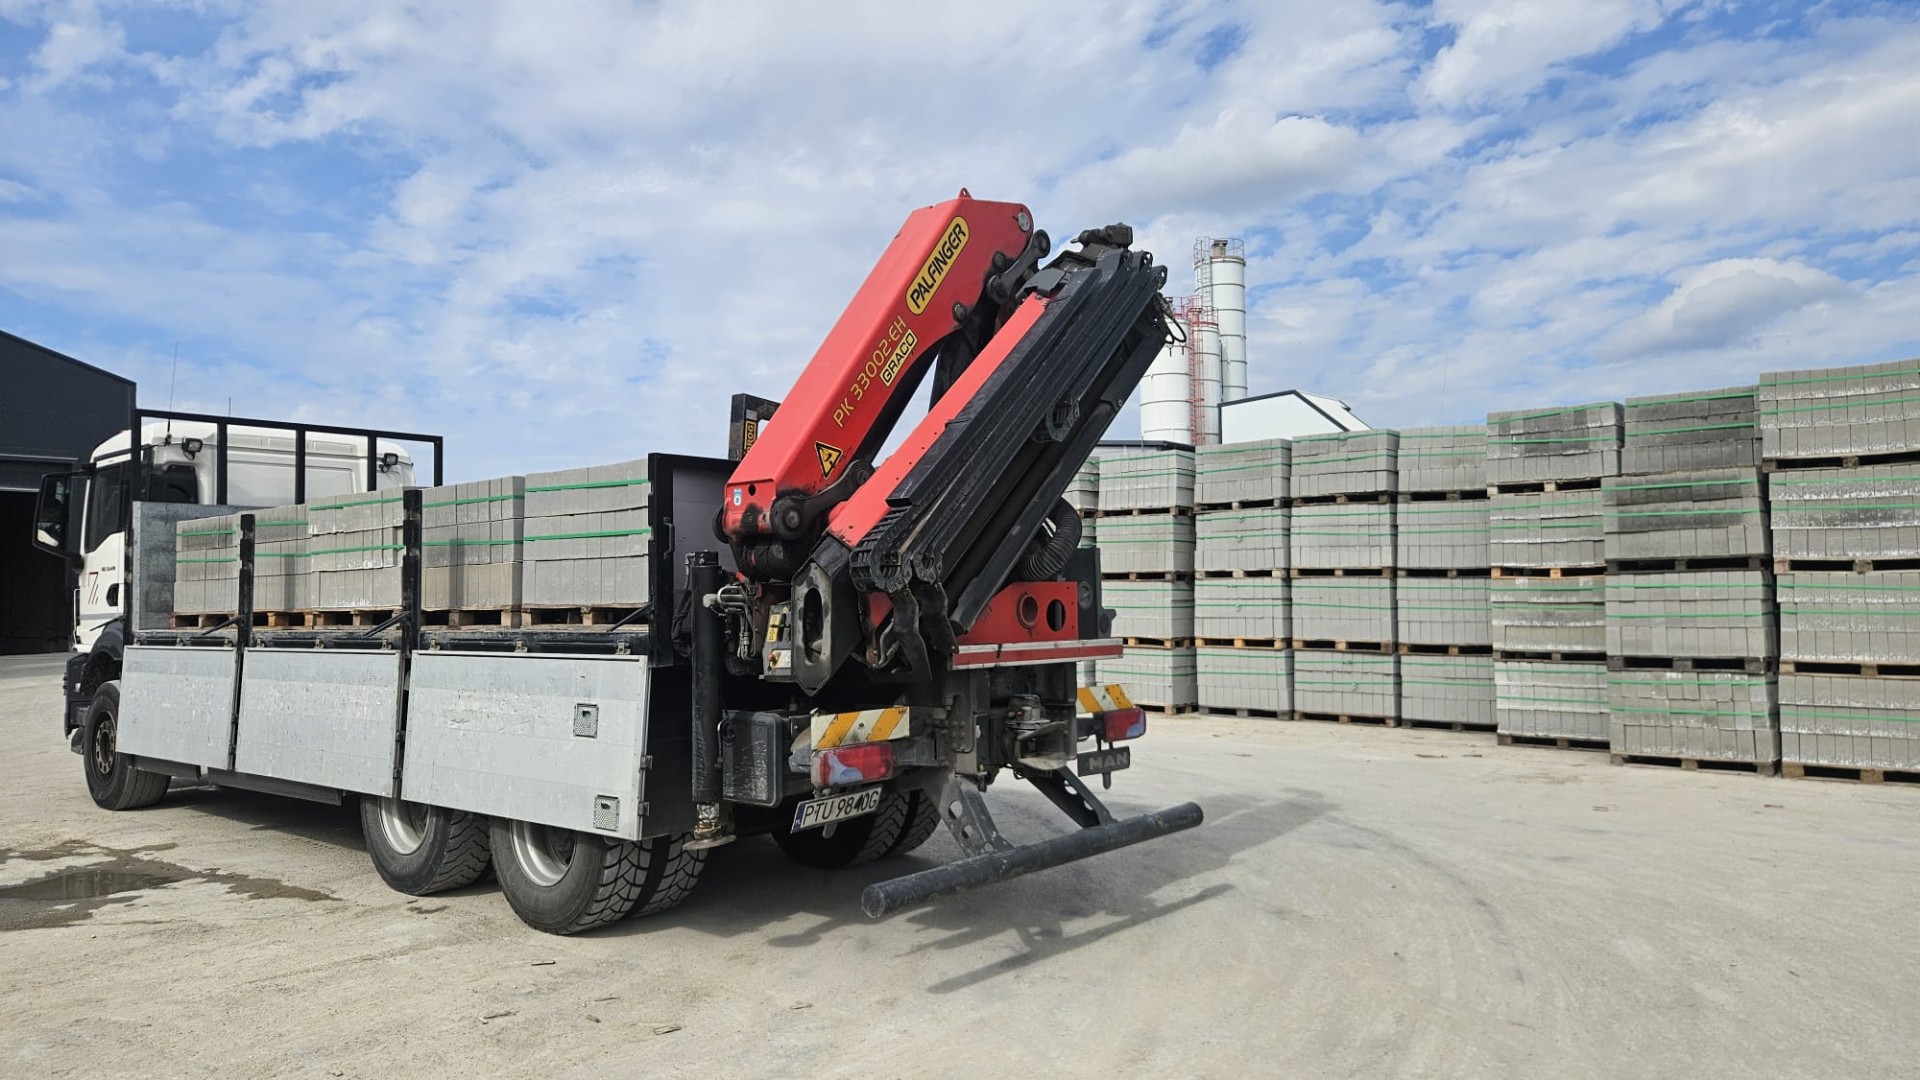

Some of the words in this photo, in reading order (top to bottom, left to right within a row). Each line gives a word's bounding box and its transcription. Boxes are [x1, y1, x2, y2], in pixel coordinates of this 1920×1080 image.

[909, 222, 967, 309] PALFINGER
[882, 332, 915, 383] GRACO
[833, 397, 854, 428] PK
[1089, 751, 1128, 770] MAN
[803, 801, 833, 825] PTU
